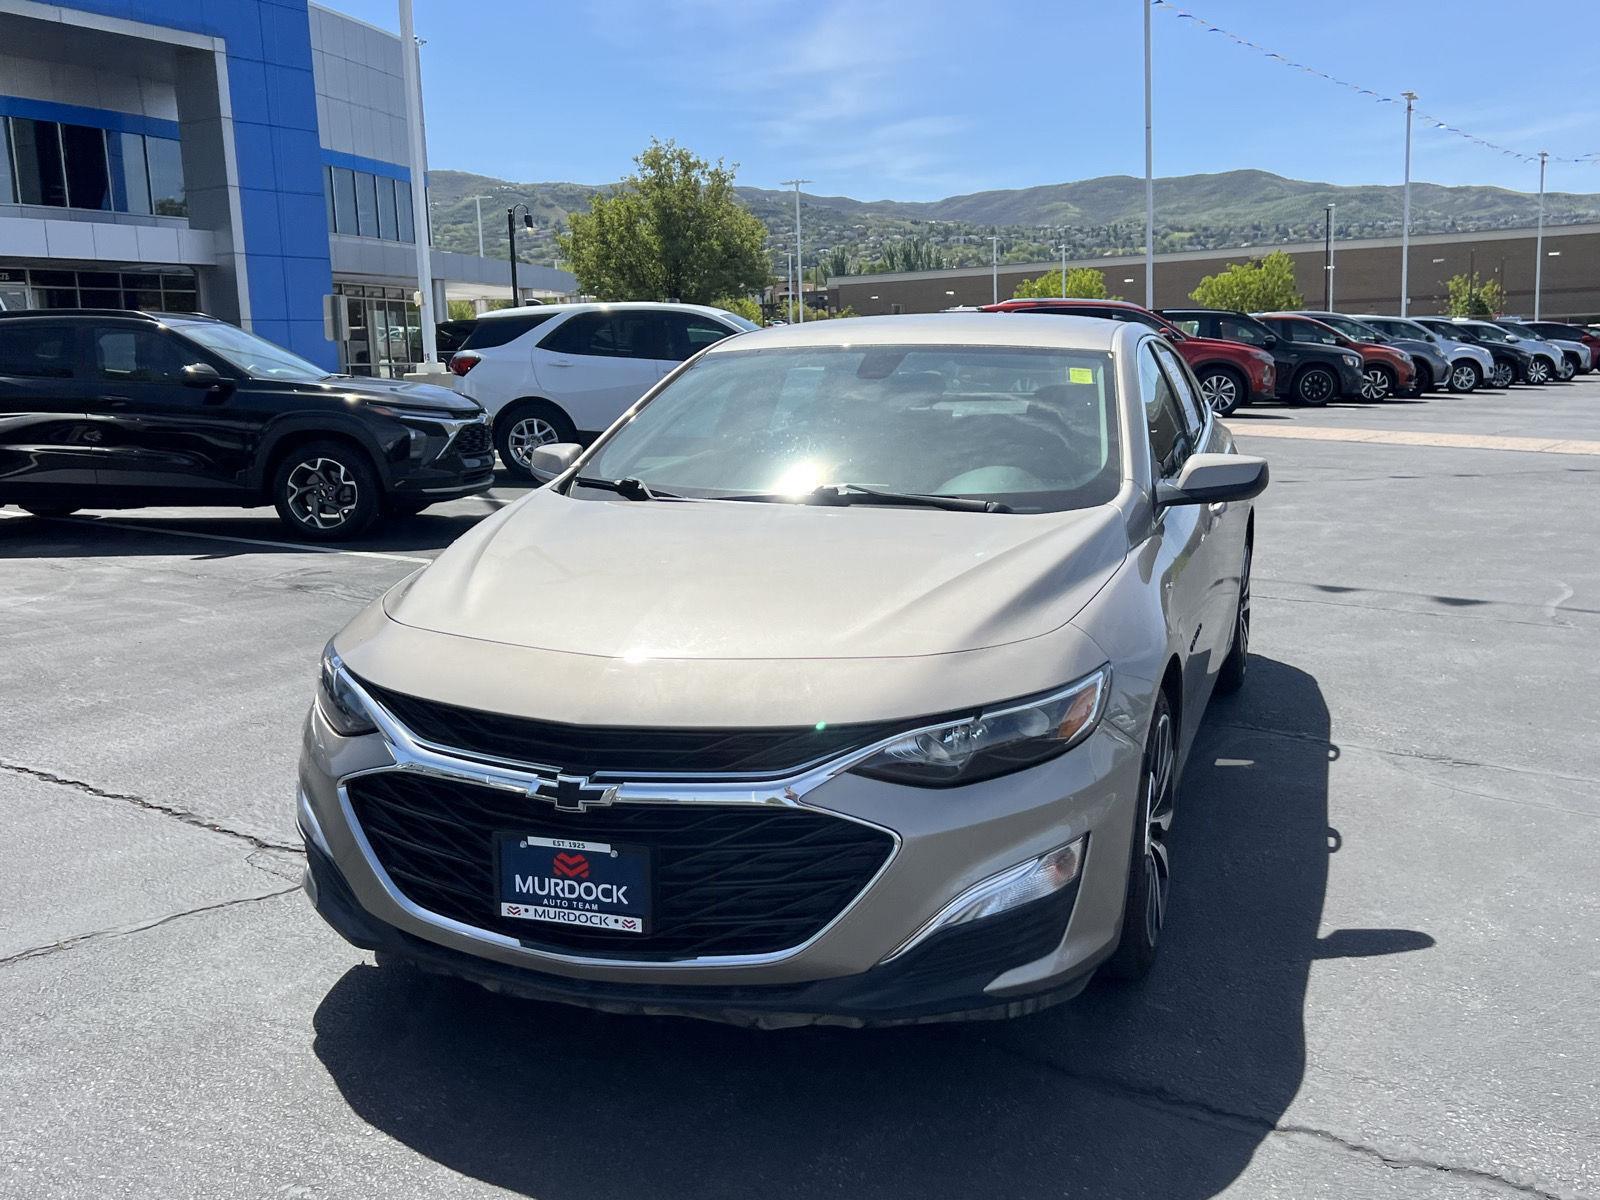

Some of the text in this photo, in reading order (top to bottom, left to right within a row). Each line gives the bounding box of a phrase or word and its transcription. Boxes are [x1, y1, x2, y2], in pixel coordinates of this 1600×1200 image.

[568, 841, 586, 849] 1925
[515, 874, 628, 905] MURDOCK
[543, 899, 599, 911] AUTO TEAM
[534, 908, 610, 927] MURDOCK
